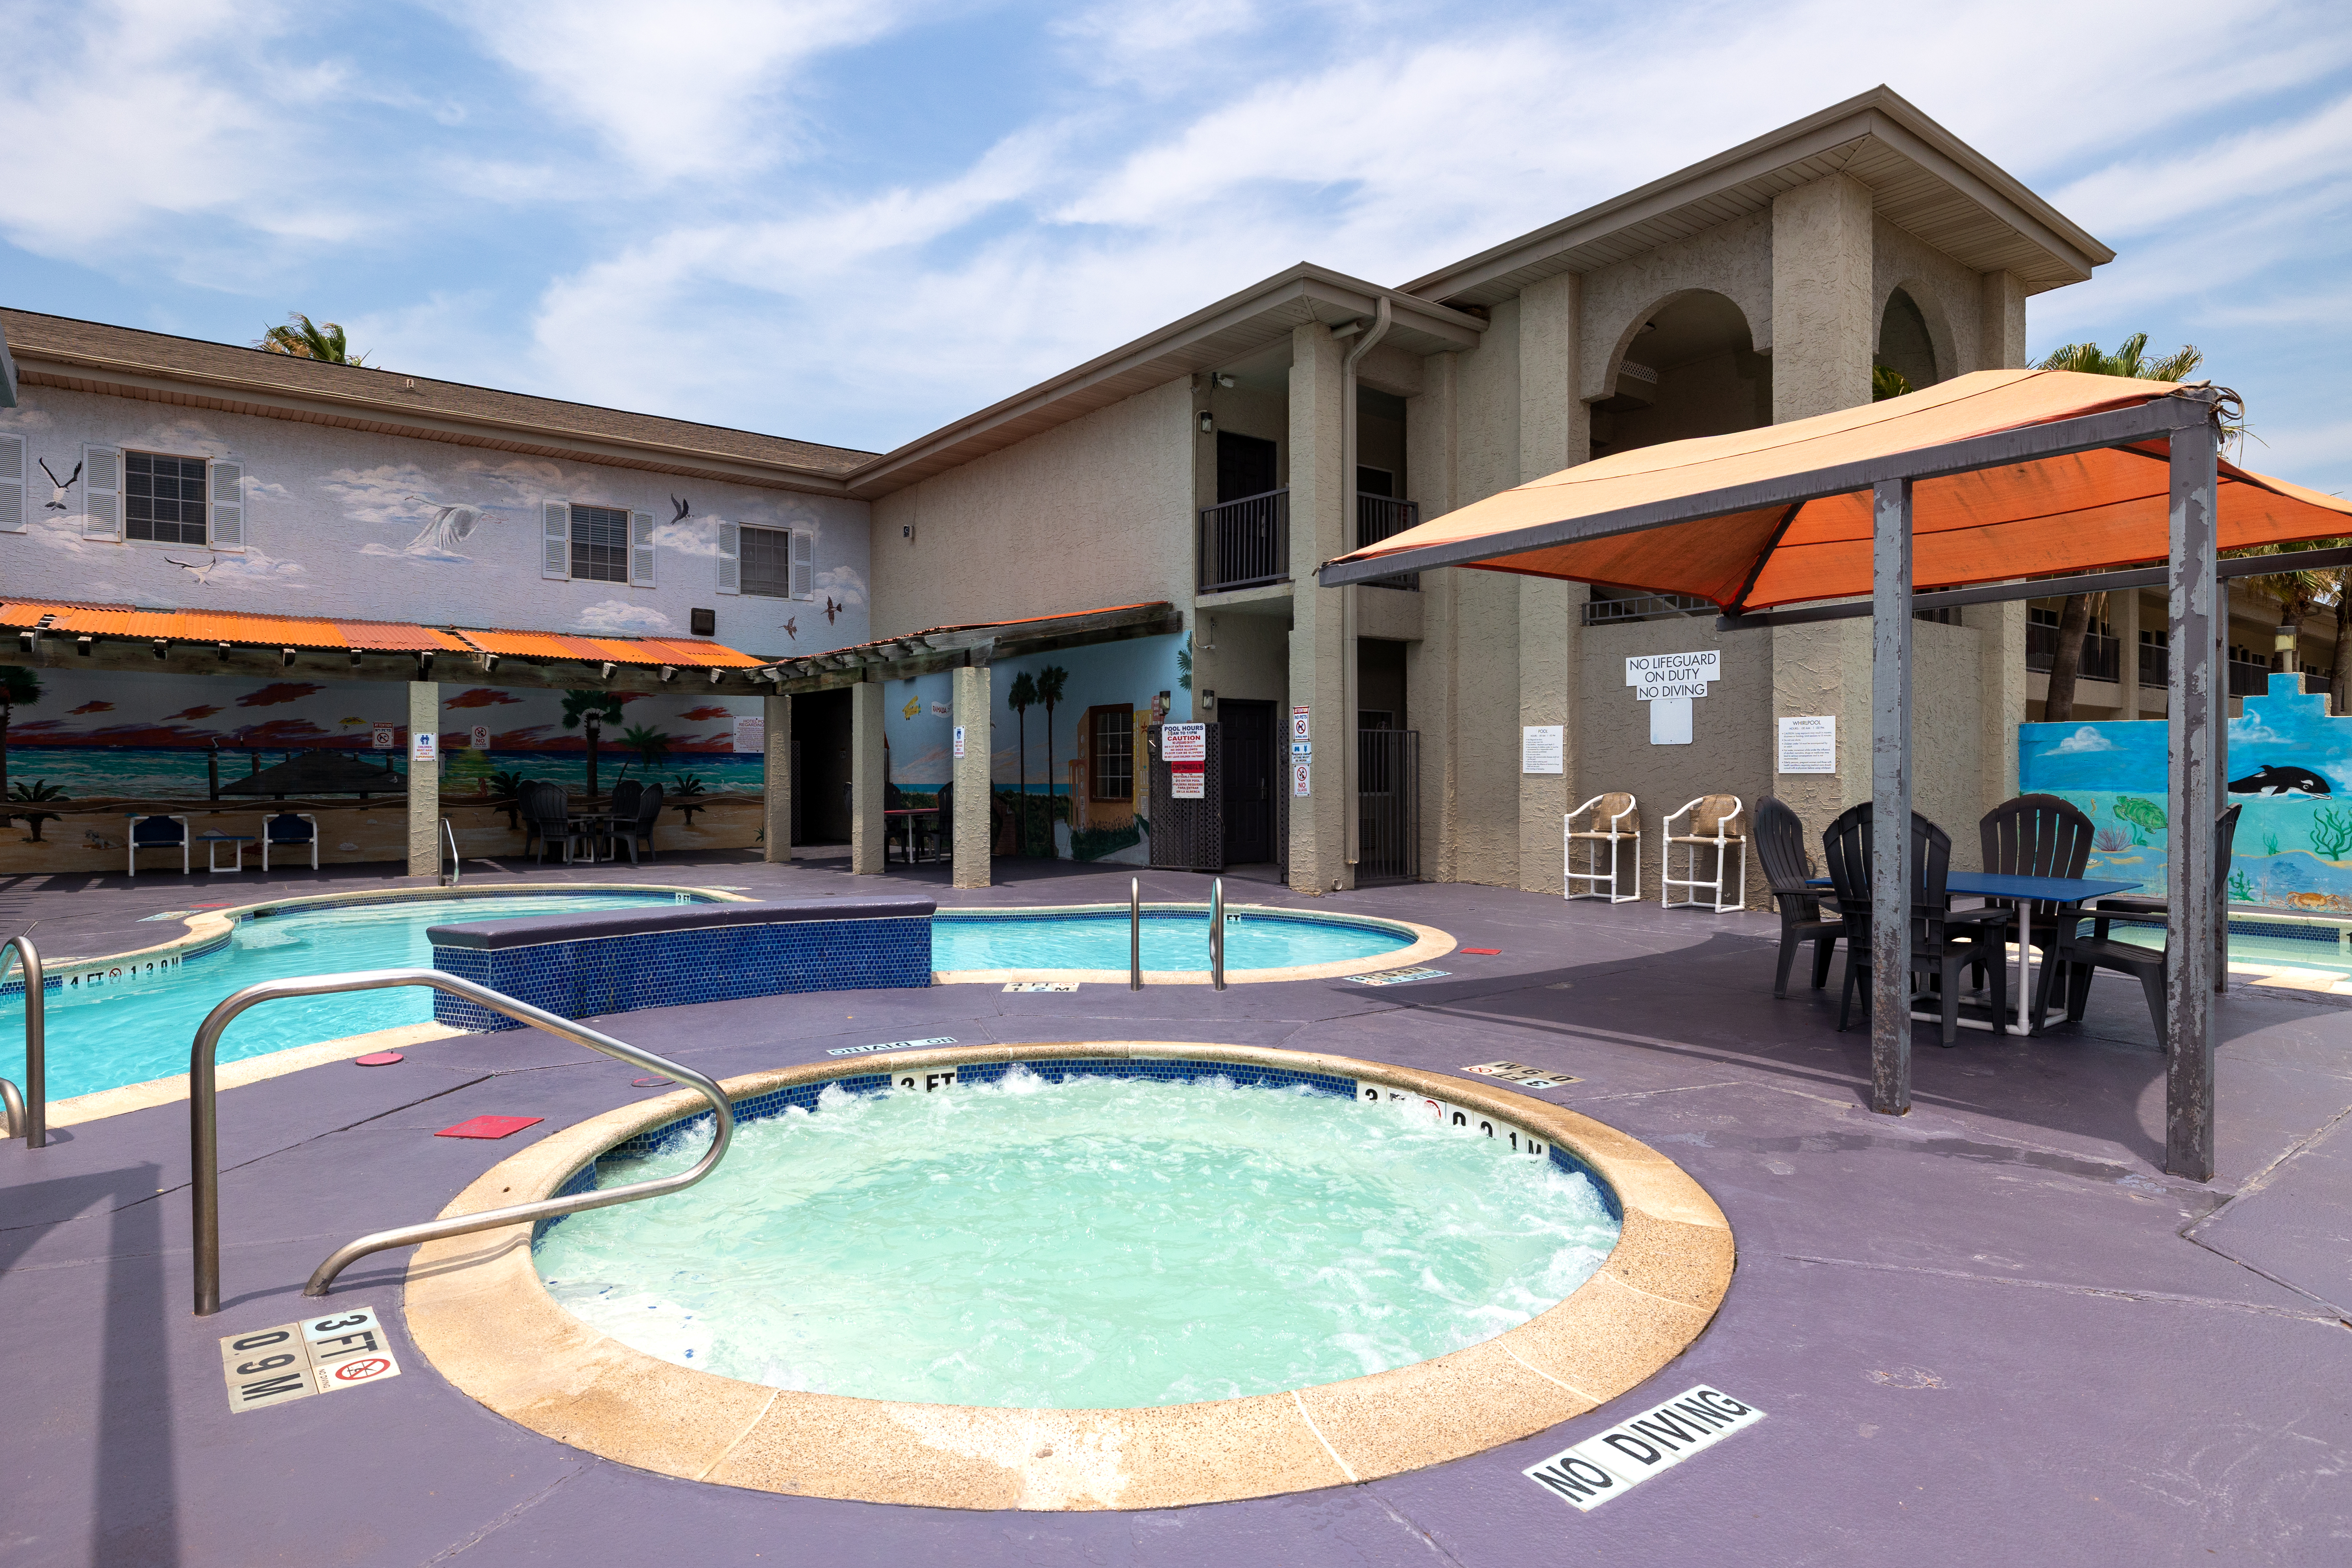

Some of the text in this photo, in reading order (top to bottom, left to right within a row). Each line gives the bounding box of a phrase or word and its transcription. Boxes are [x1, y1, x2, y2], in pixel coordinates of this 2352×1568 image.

[1630, 653, 1716, 671] NO LIFEGUARD
[1645, 668, 1700, 683] ON DUTY
[1640, 684, 1705, 698] NO DIVING
[933, 705, 947, 714] RAMADA
[87, 972, 104, 982] FT
[172, 957, 178, 965] M
[1403, 971, 1448, 980] DIVING
[830, 1042, 912, 1054] DIVING
[926, 1072, 955, 1093] FT
[1491, 1073, 1528, 1081] FT
[1528, 1139, 1542, 1155] M
[315, 1314, 379, 1359] 3 FT
[241, 1372, 303, 1401] M
[320, 1375, 331, 1388] DIVING
[1532, 1390, 1752, 1503] NO DIVING
